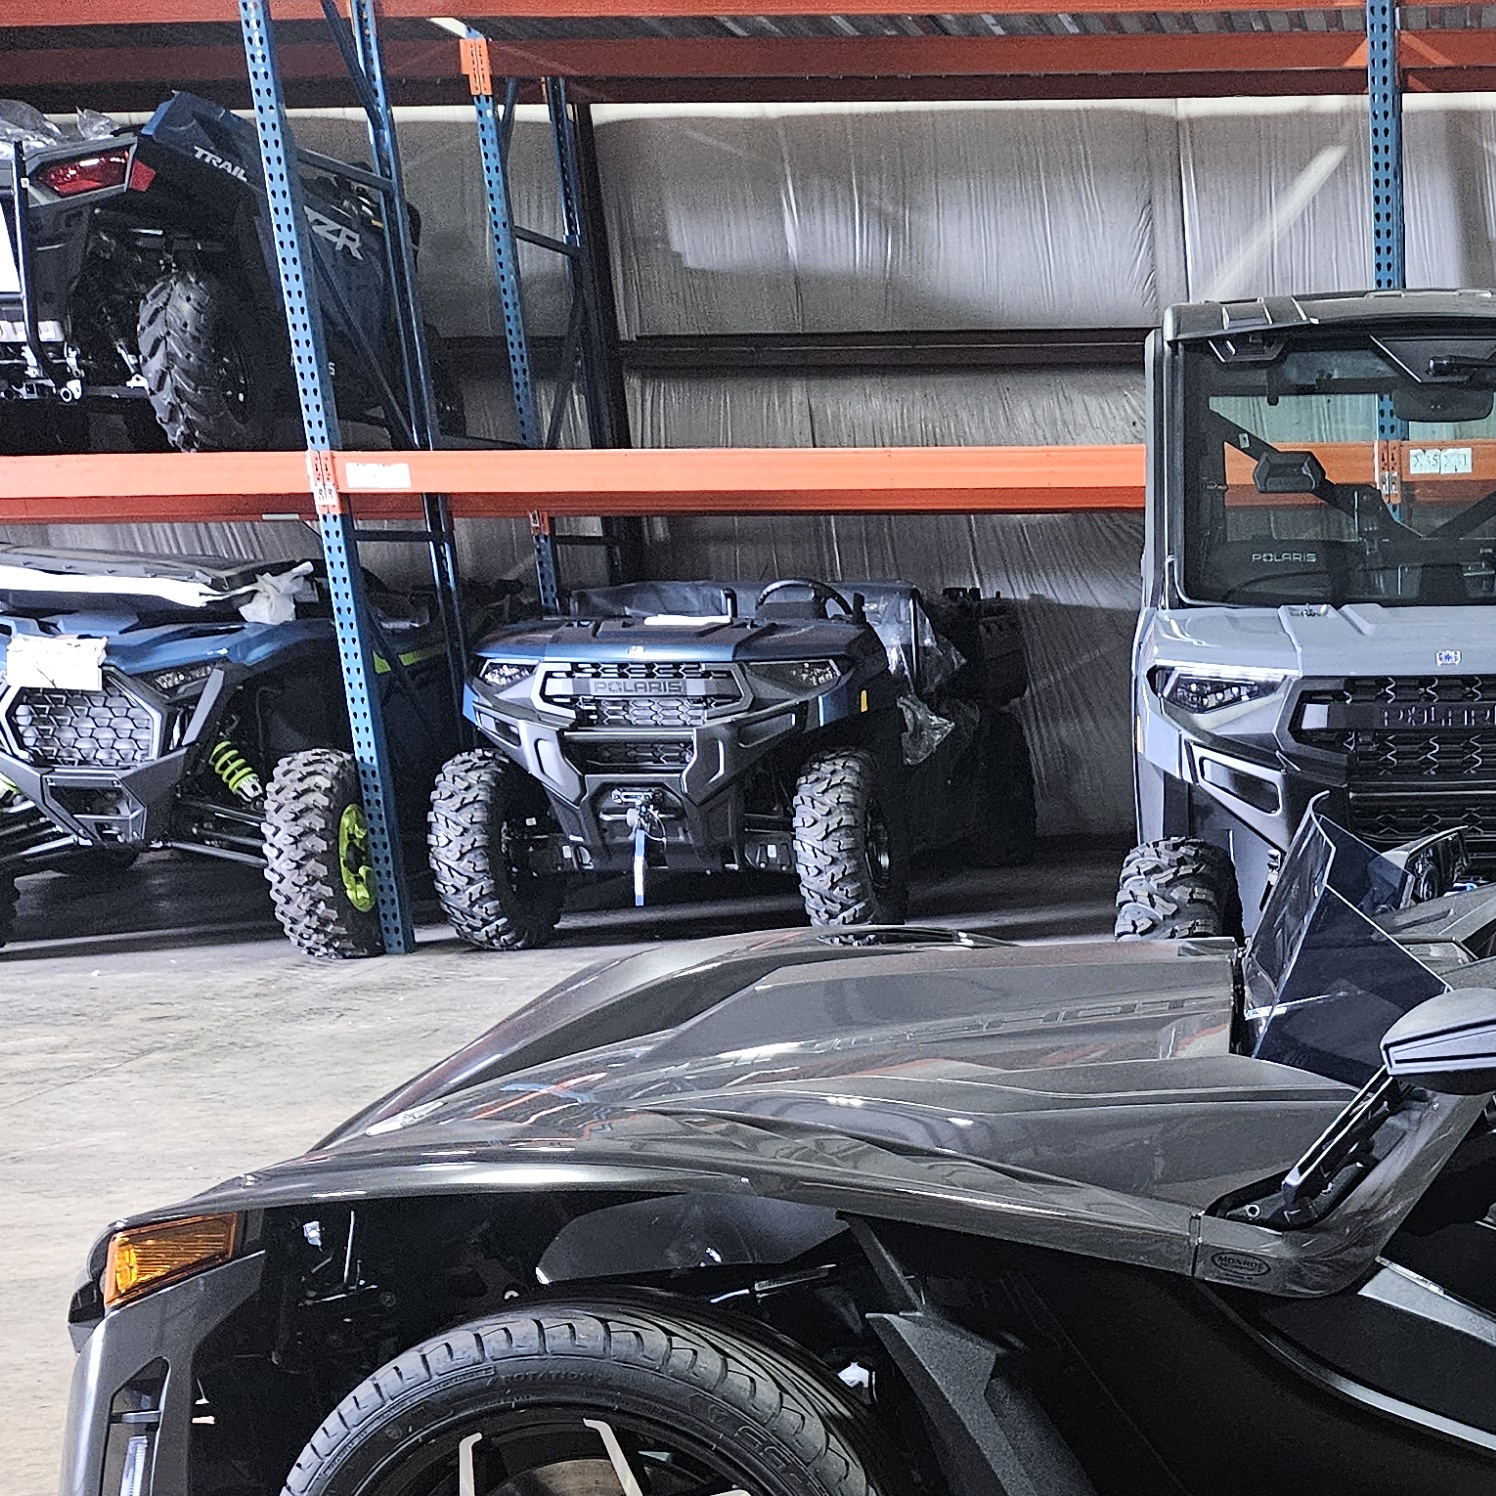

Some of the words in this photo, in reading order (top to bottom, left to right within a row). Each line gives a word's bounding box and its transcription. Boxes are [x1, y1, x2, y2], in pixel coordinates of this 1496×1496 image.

[194, 145, 247, 182] TRAIL
[1251, 552, 1317, 563] POLARIS
[593, 681, 682, 693] POLARIS
